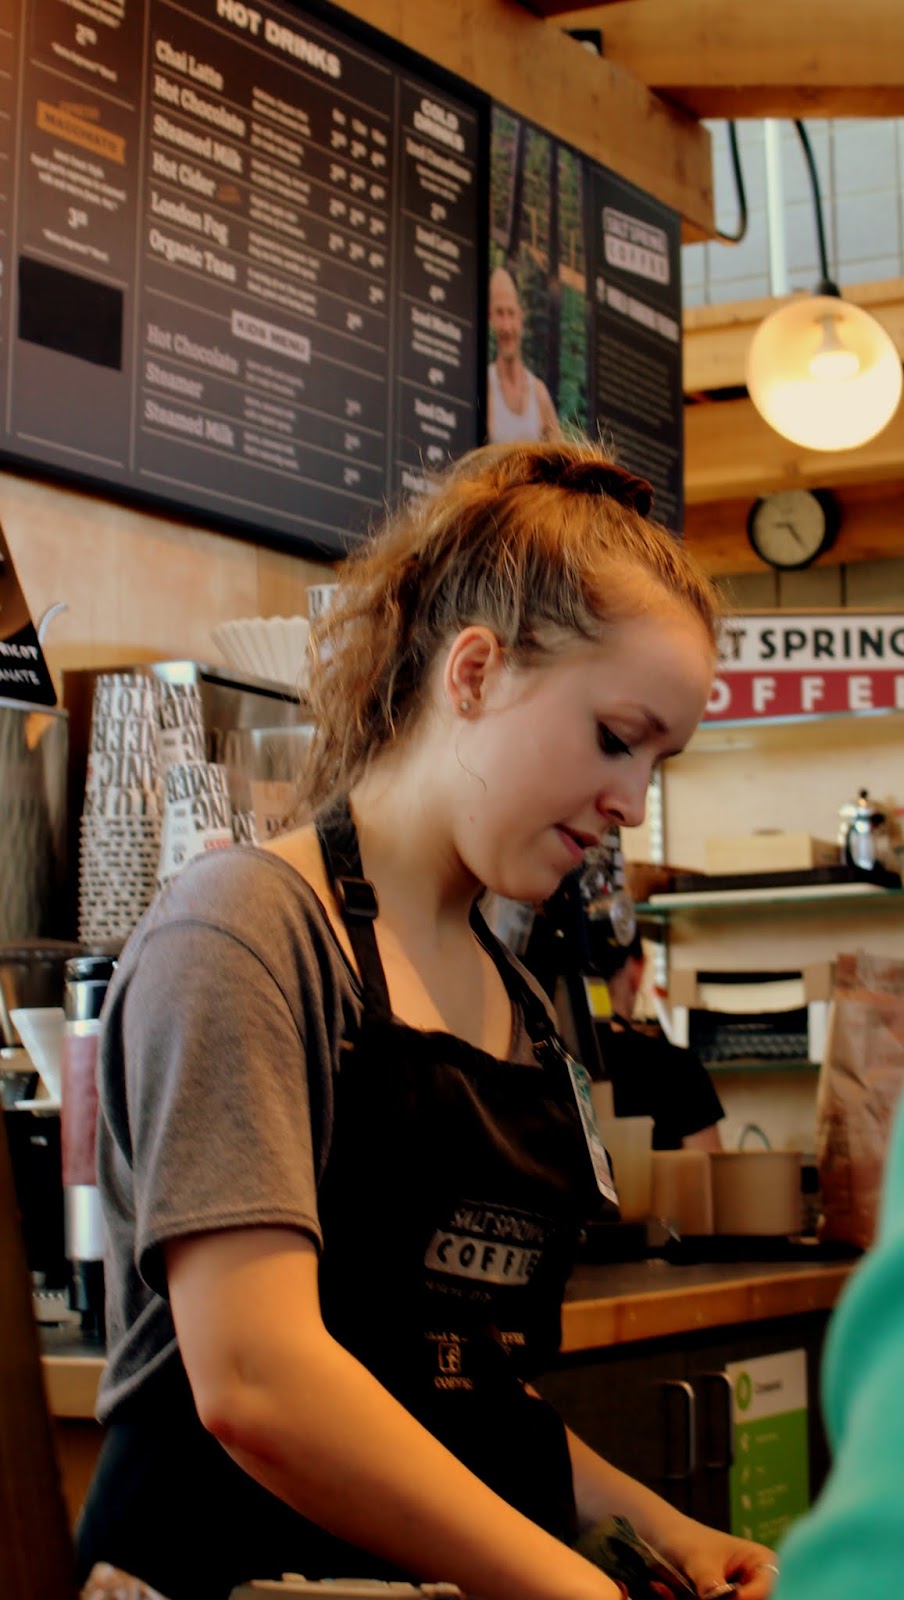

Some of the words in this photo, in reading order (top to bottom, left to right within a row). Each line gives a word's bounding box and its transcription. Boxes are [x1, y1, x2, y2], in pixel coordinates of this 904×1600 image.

[155, 38, 188, 73] Chai
[188, 54, 224, 91] Latte
[216, 0, 262, 35] HOT
[264, 18, 342, 79] DRINKS
[155, 74, 180, 105] Hot
[180, 87, 246, 137] Chocolate
[153, 113, 213, 159] Steamed
[213, 139, 243, 174] Milk
[152, 151, 179, 181] Hot
[178, 162, 217, 198] Cider
[151, 190, 203, 232] London
[203, 212, 229, 248] Fog
[149, 228, 204, 267] Organic
[204, 249, 237, 283] Teas
[147, 322, 173, 351] Hot
[173, 331, 240, 376] Chocolate
[145, 360, 204, 400] Steamer
[145, 398, 204, 437] Steamed
[204, 418, 235, 448] Milk
[0, 641, 38, 661] RICOT
[705, 674, 904, 713] OFFE
